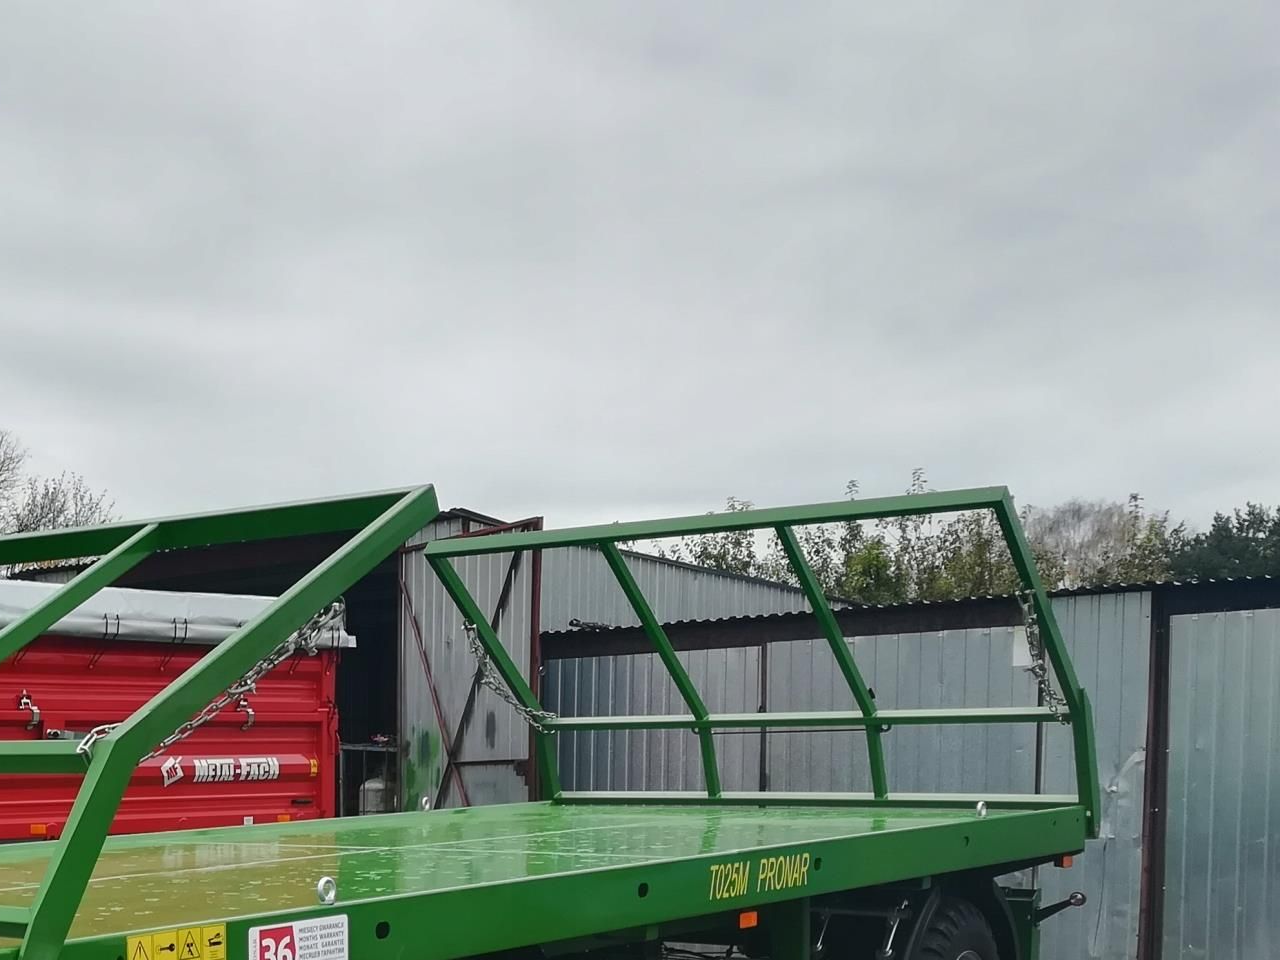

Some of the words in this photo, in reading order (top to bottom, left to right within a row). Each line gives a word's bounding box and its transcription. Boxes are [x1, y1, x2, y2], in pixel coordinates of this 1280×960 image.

[193, 757, 280, 783] METAL-FACH
[709, 860, 751, 901] T025M
[756, 852, 810, 893] PRONAR
[319, 931, 344, 940] WARRANTY
[321, 938, 344, 948] GARANTIE
